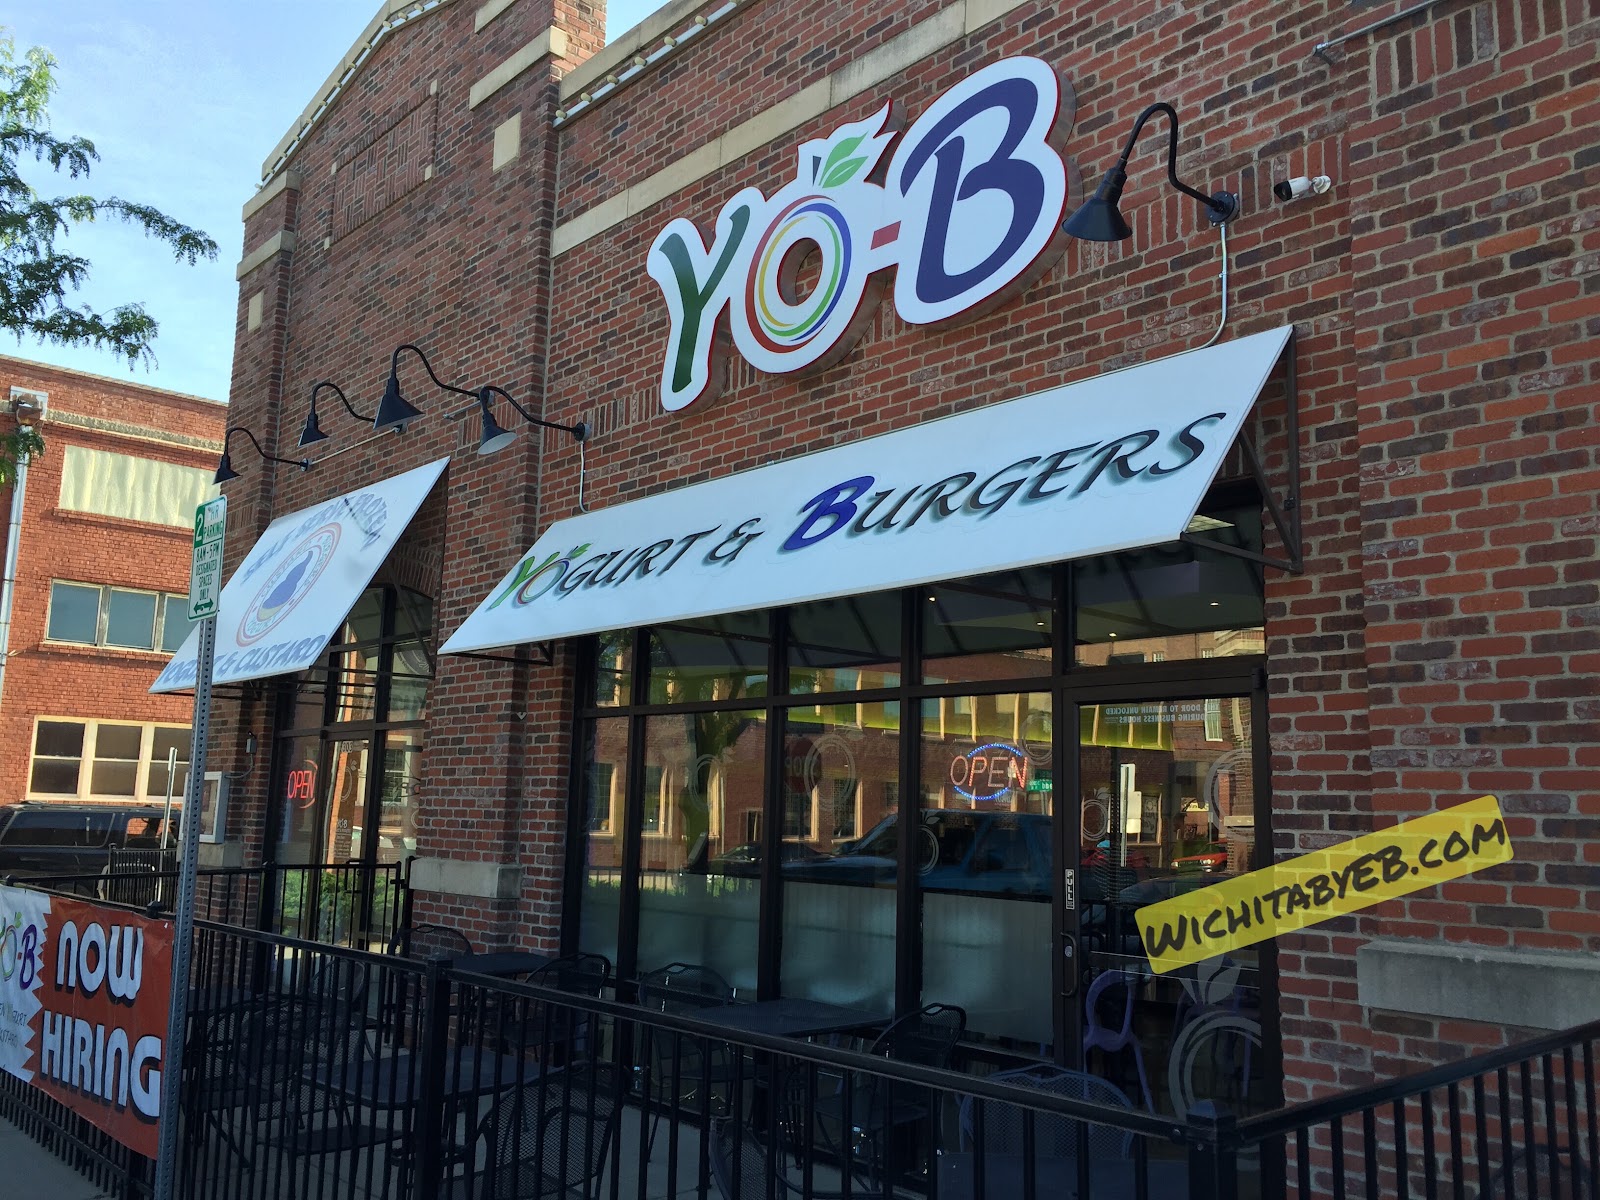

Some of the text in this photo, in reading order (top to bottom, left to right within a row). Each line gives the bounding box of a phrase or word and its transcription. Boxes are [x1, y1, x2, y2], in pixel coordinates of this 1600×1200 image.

[658, 76, 1045, 395] YO-B
[195, 504, 220, 542] 2 HR
[203, 520, 223, 538] PARKING
[485, 411, 1227, 613] YOGURT & BURGERS
[195, 558, 218, 577] DESIGNATED
[198, 573, 213, 589] SPACES
[199, 587, 210, 601] ONLY
[156, 634, 326, 684] YOGUT & CUSTARD
[287, 770, 316, 800] OPEN
[950, 755, 1028, 788] OPEN
[57, 919, 144, 1001] NOW
[41, 1010, 162, 1117] HIRING
